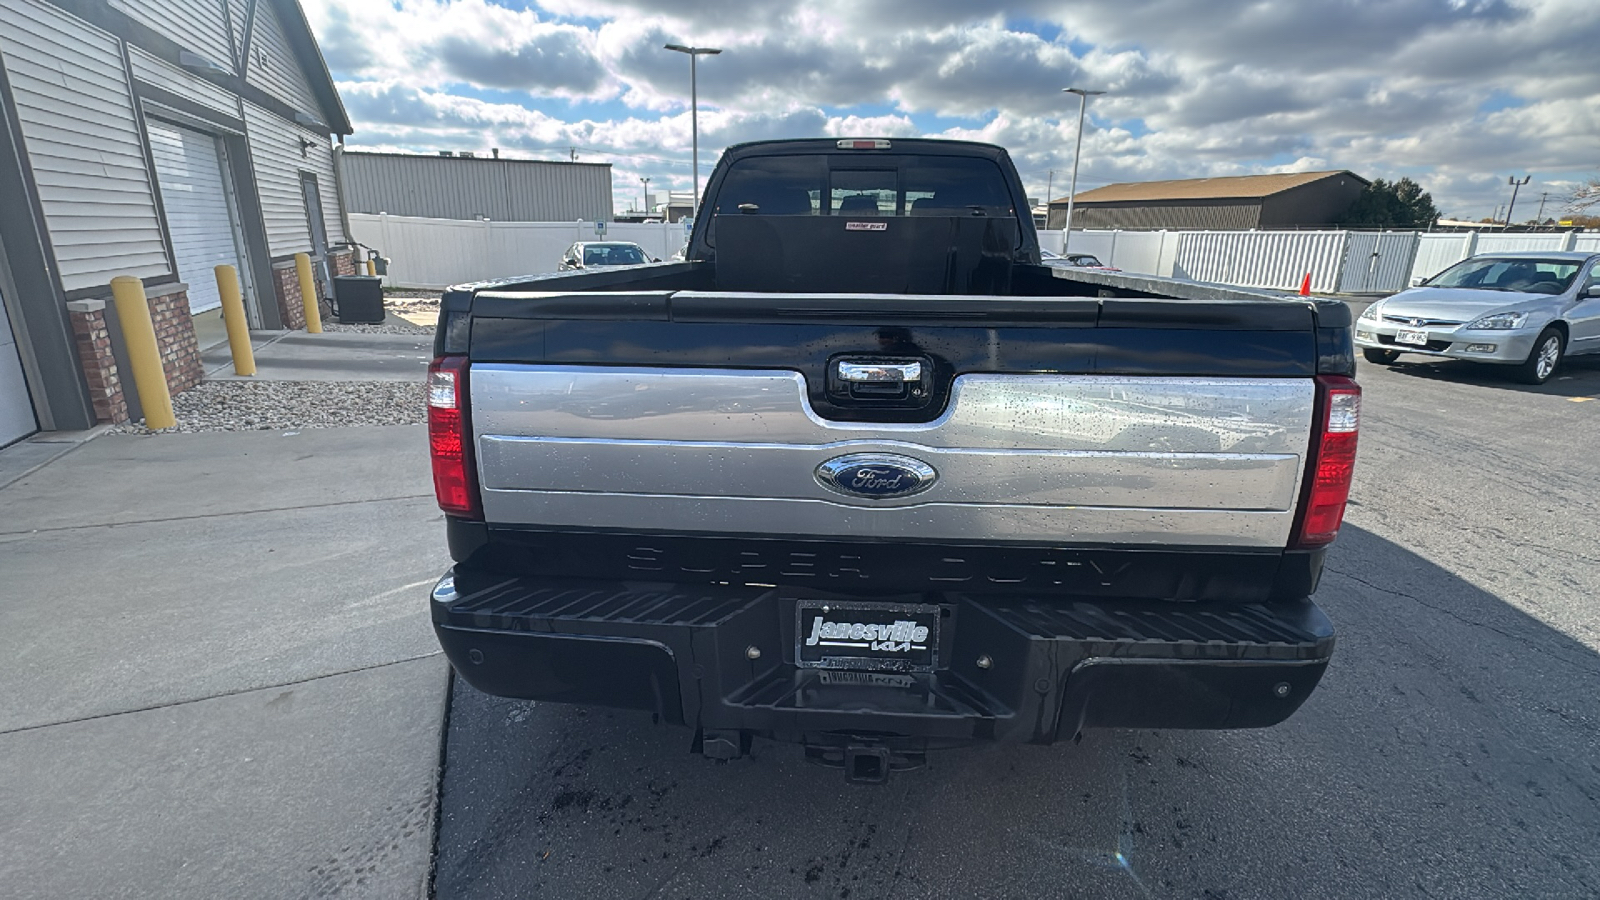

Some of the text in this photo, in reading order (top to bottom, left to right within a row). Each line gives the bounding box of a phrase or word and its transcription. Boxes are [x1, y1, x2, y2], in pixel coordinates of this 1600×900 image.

[851, 468, 902, 489] Ford
[626, 547, 870, 579] SUPER
[806, 616, 929, 646] Janesville
[871, 641, 911, 652] KIA
